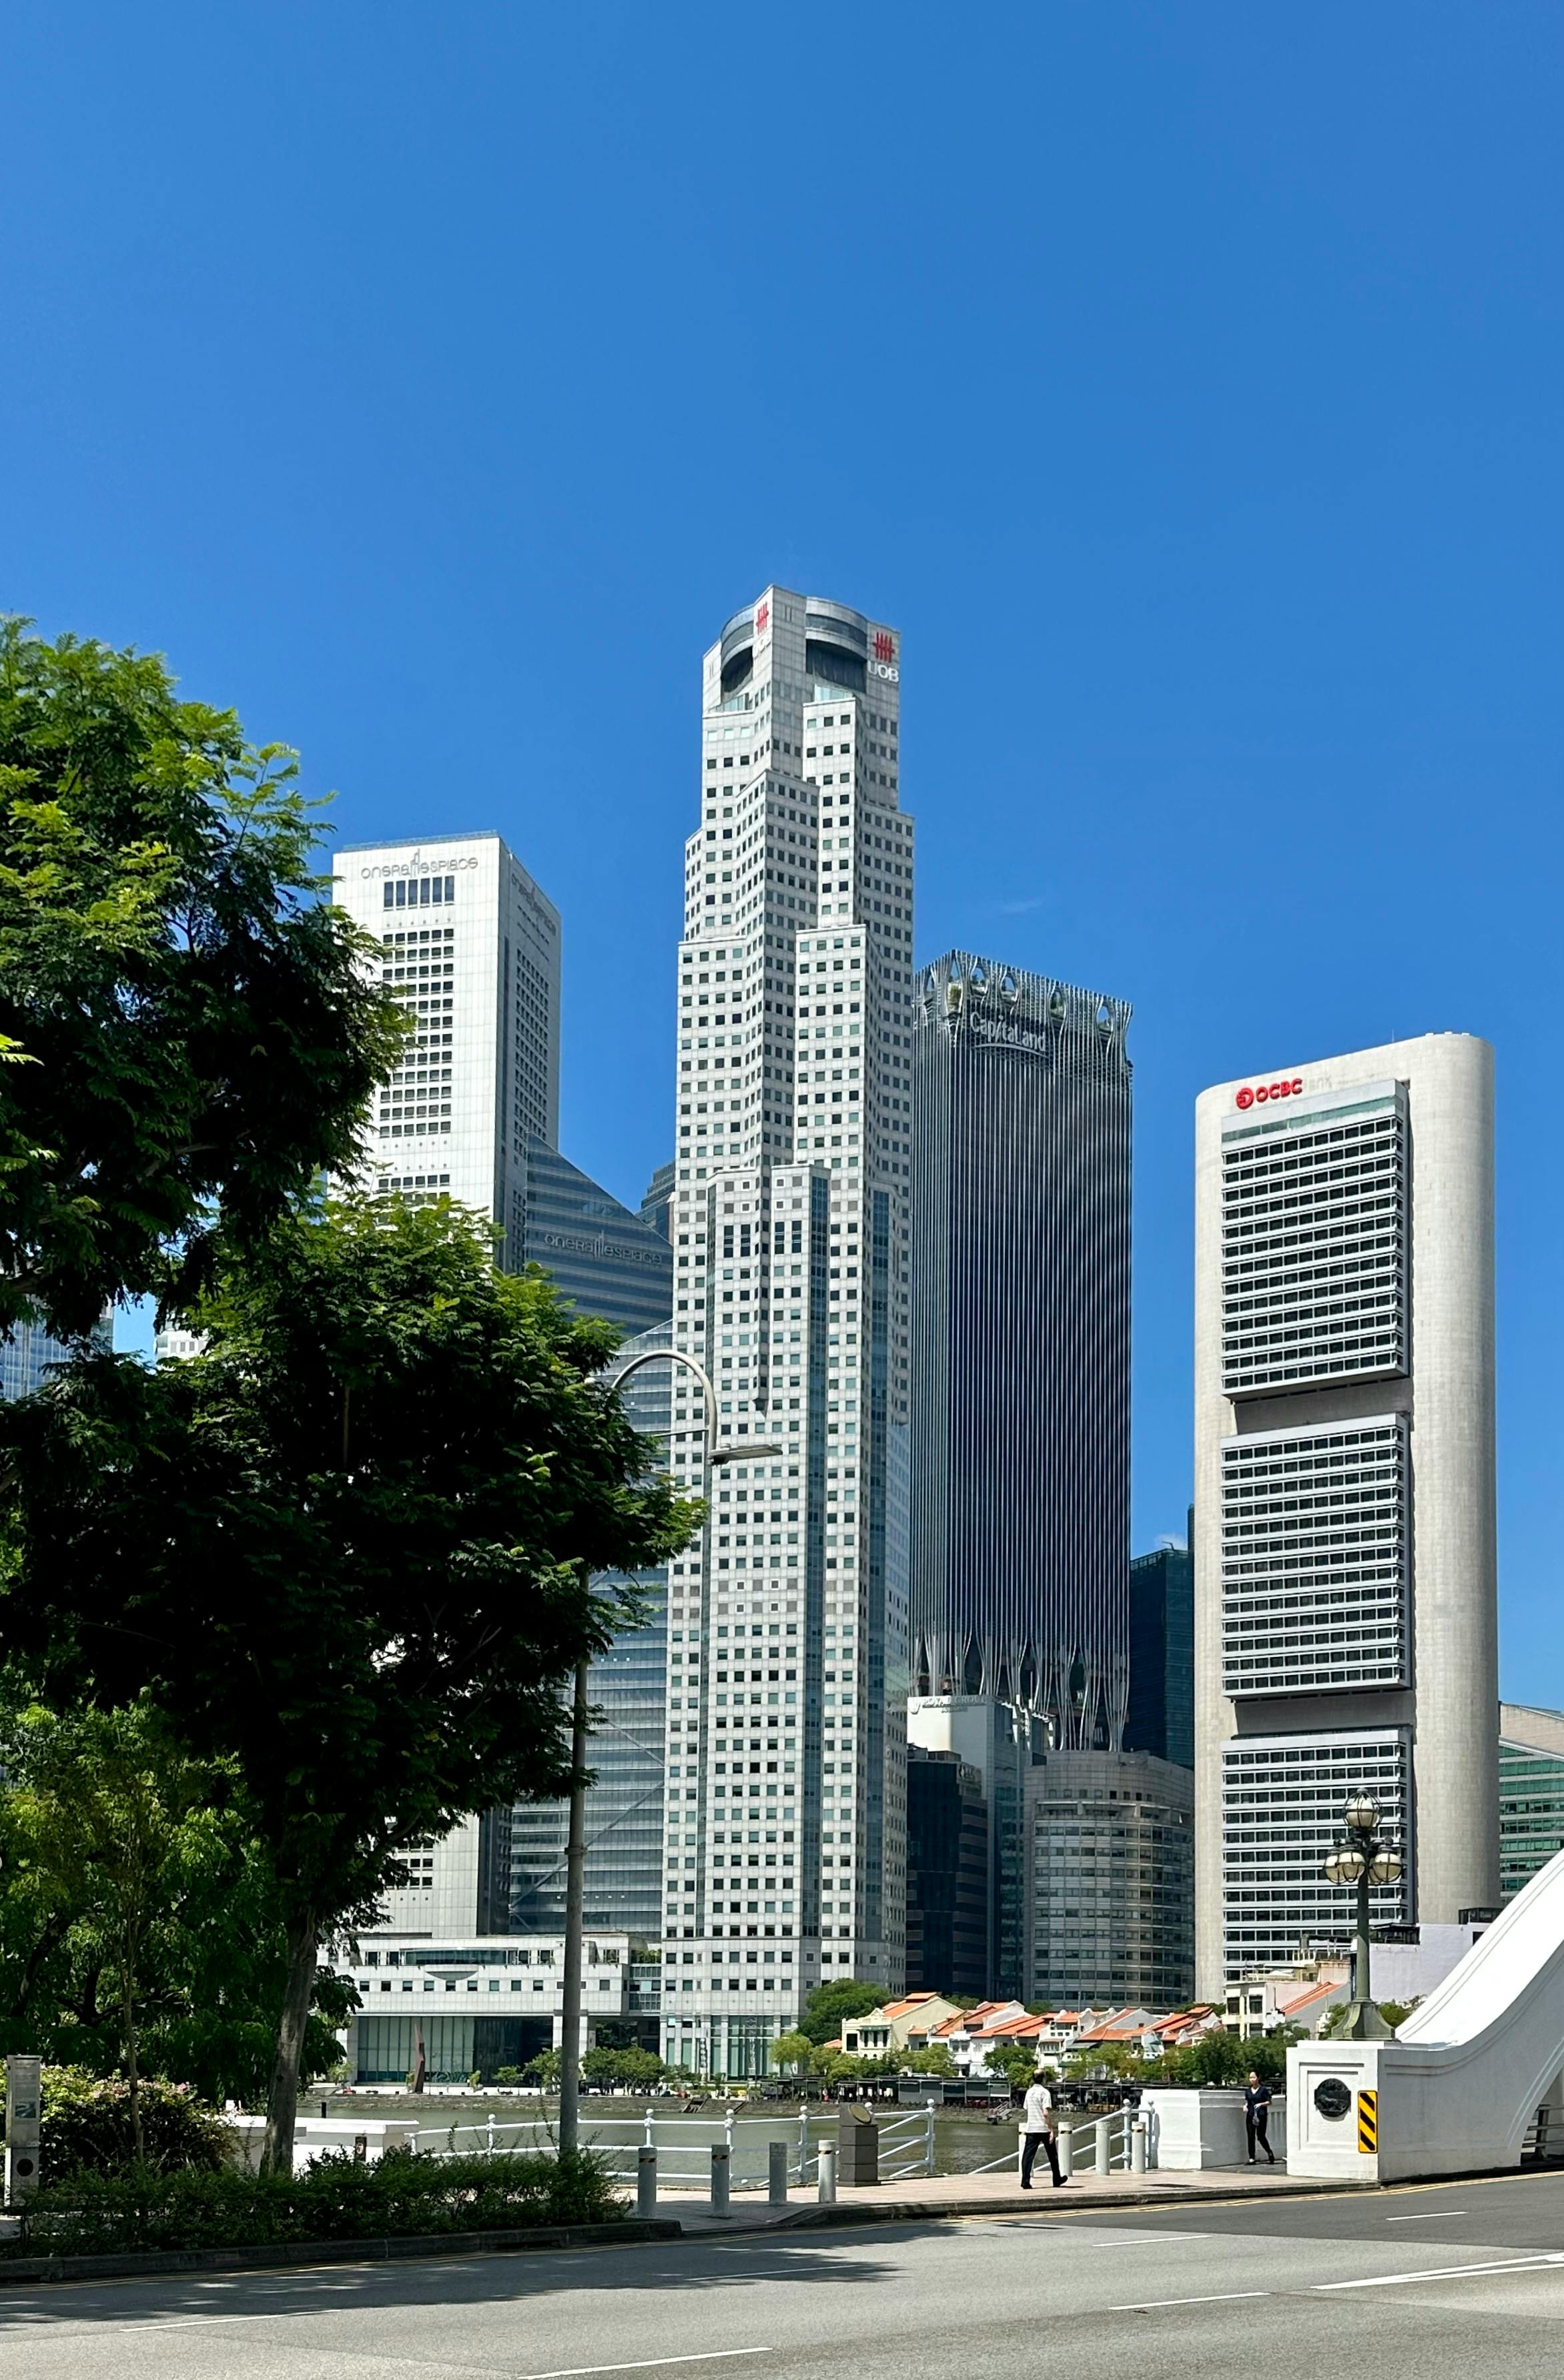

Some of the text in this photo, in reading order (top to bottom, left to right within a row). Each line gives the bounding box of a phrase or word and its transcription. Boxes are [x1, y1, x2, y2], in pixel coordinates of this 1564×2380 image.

[867, 660, 899, 683] UOB
[970, 1010, 1046, 1052] CapitaLand
[1256, 1078, 1302, 1103] OCBC
